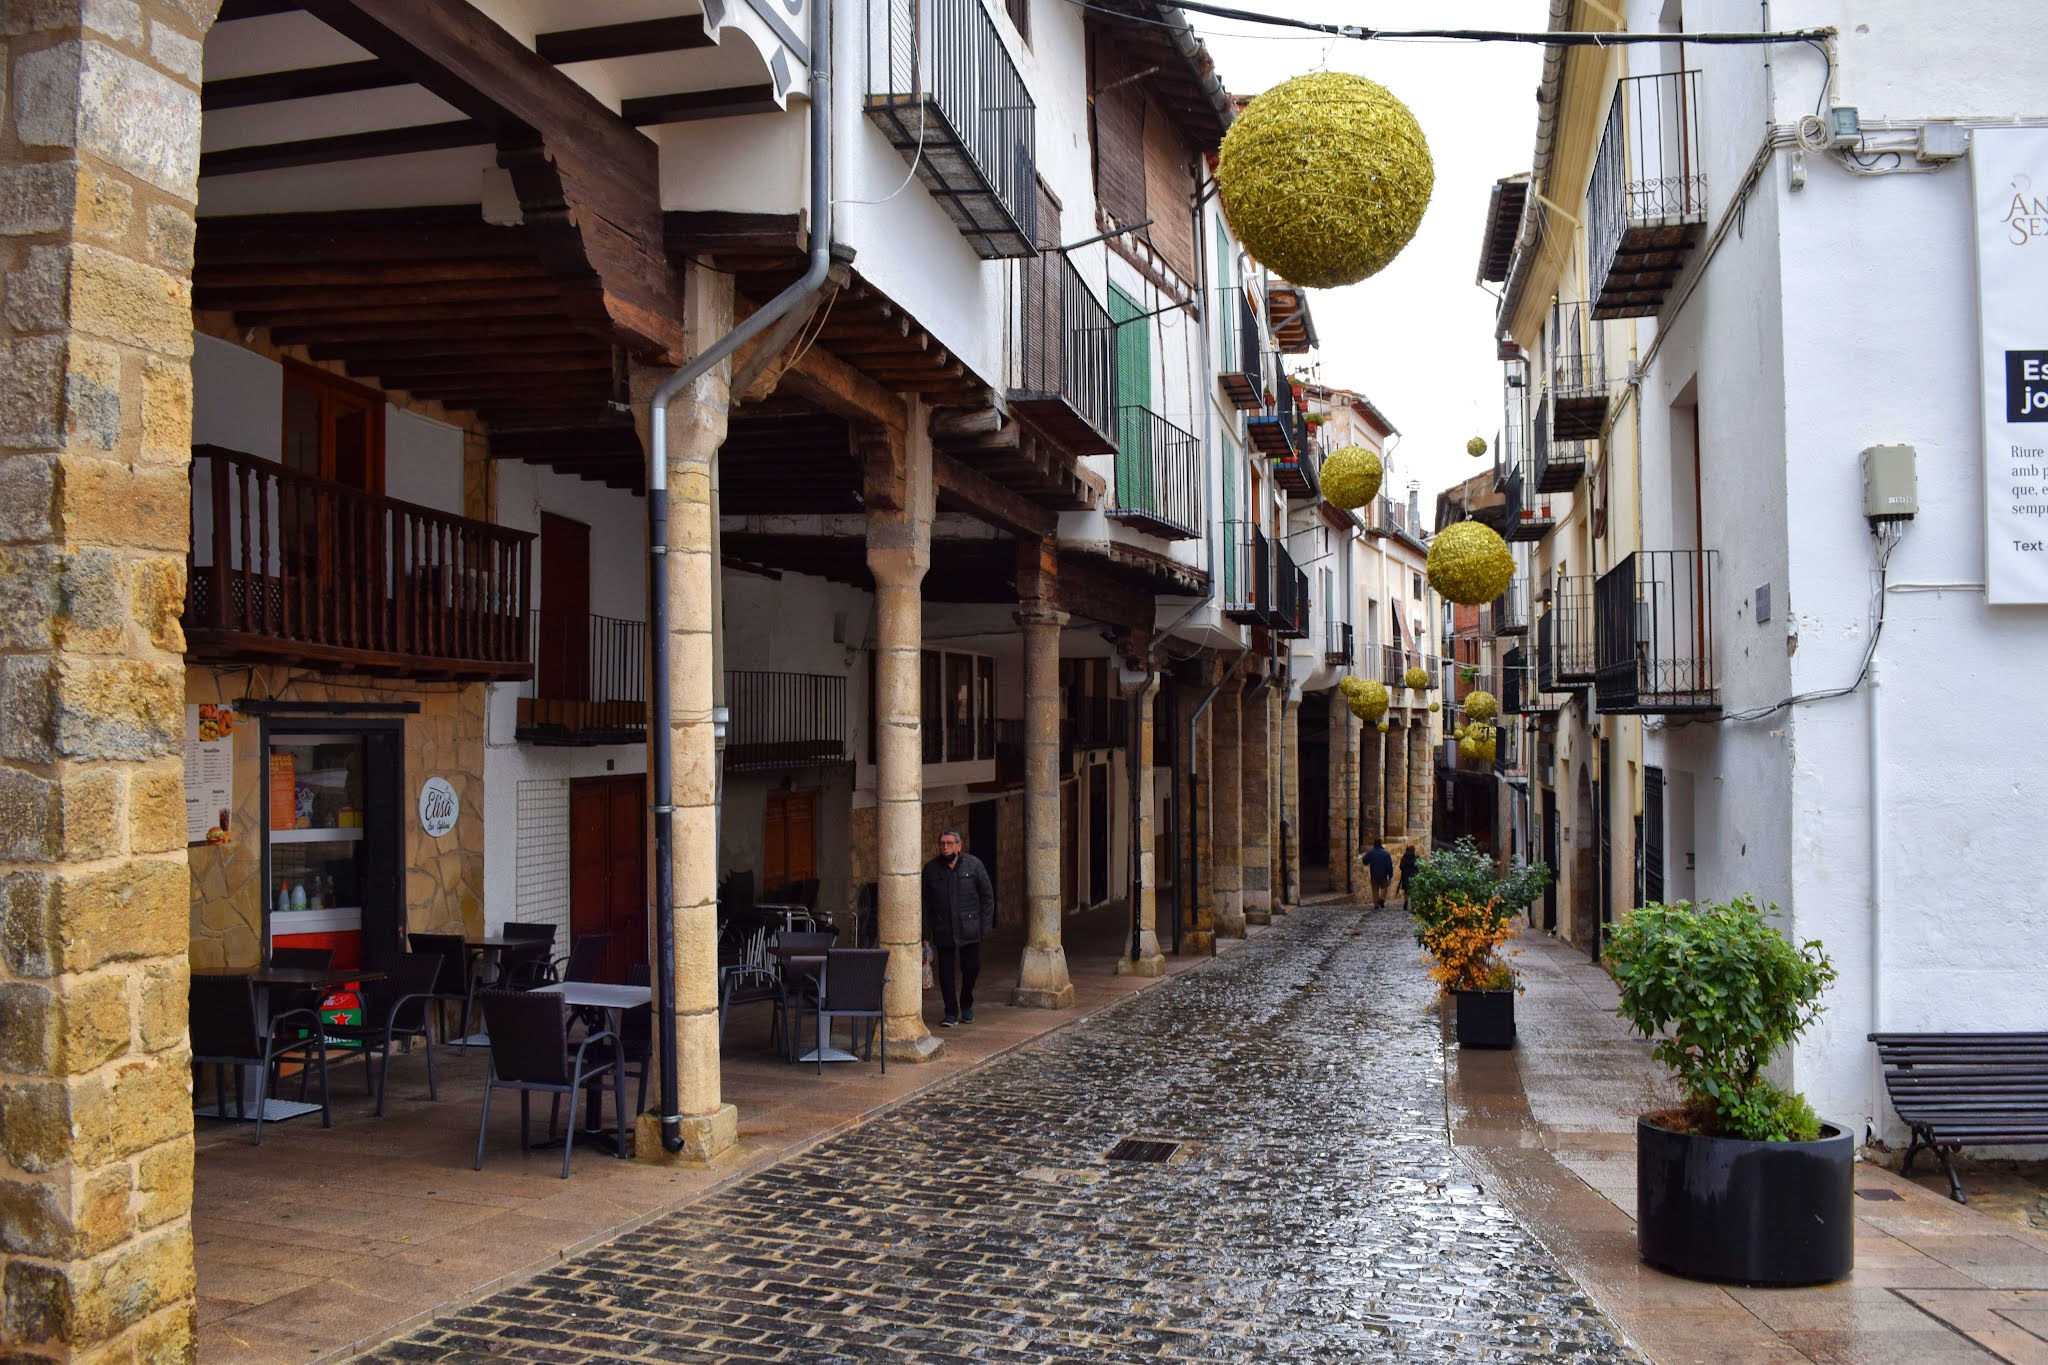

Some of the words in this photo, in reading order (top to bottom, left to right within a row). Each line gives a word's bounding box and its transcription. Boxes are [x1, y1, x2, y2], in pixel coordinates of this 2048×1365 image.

[2011, 445, 2044, 458] Riure
[2011, 464, 2039, 477] amb
[2011, 486, 2038, 499] que,
[2013, 540, 2044, 551] Text
[425, 791, 452, 821] Elisa
